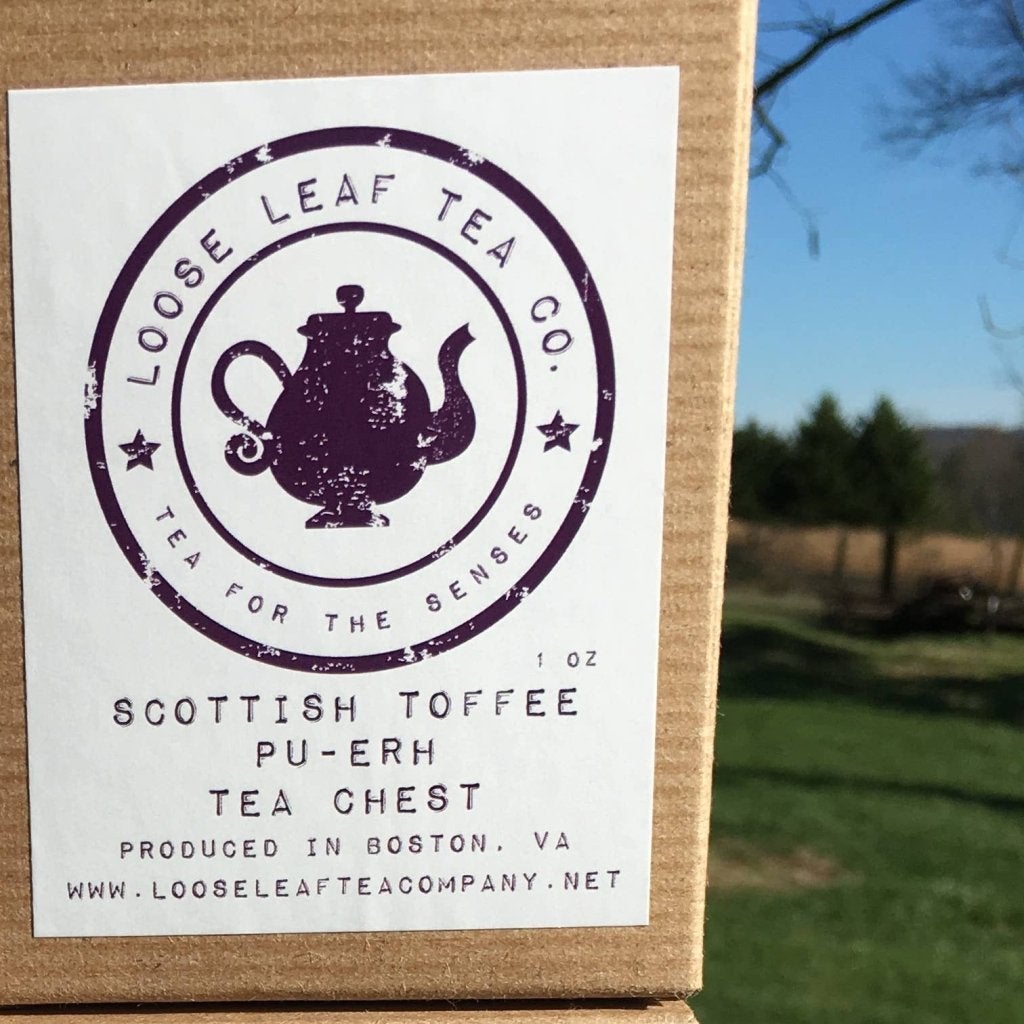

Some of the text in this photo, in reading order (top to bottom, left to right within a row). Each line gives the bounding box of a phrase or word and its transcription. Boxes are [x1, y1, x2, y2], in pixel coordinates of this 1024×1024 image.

[126, 173, 573, 386] LOOSE LEAF TEA CO.
[155, 503, 542, 634] TEA FOR THE SENSES
[536, 650, 597, 668] 1 OZ
[112, 687, 578, 728] SCOTTISH TOFFEE
[256, 737, 435, 769] PU-ERH
[208, 782, 481, 818] TEA CHEST
[120, 838, 278, 860] PRODUCED
[307, 837, 341, 857] IN
[534, 831, 570, 850] VA
[66, 869, 621, 901] WWW.LOOSELEAFTEACOMPANY.NET
